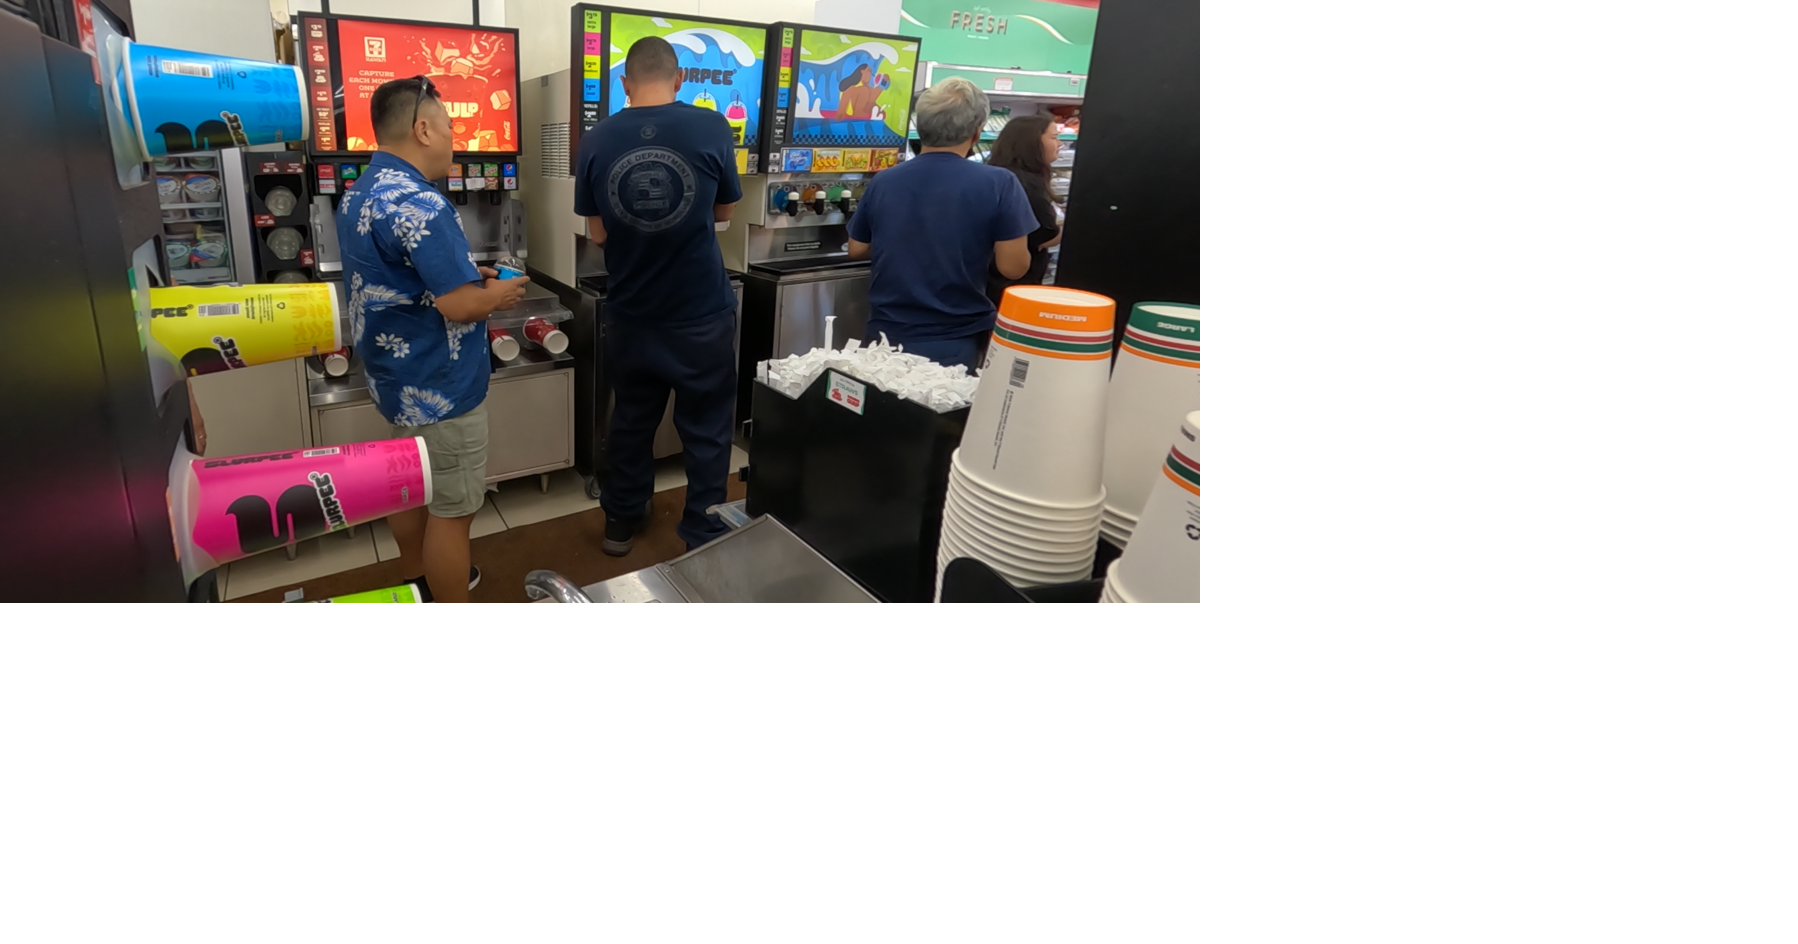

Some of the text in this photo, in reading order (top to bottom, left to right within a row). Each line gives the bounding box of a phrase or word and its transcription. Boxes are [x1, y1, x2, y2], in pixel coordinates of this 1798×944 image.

[951, 10, 1008, 35] FRESH
[442, 102, 479, 118] ULP
[610, 158, 633, 184] POLICE
[635, 152, 690, 178] DEPARTMENT
[1038, 312, 1087, 322] MEDIUM
[1157, 322, 1195, 333] LARGE
[204, 453, 294, 468] SLURPEE
